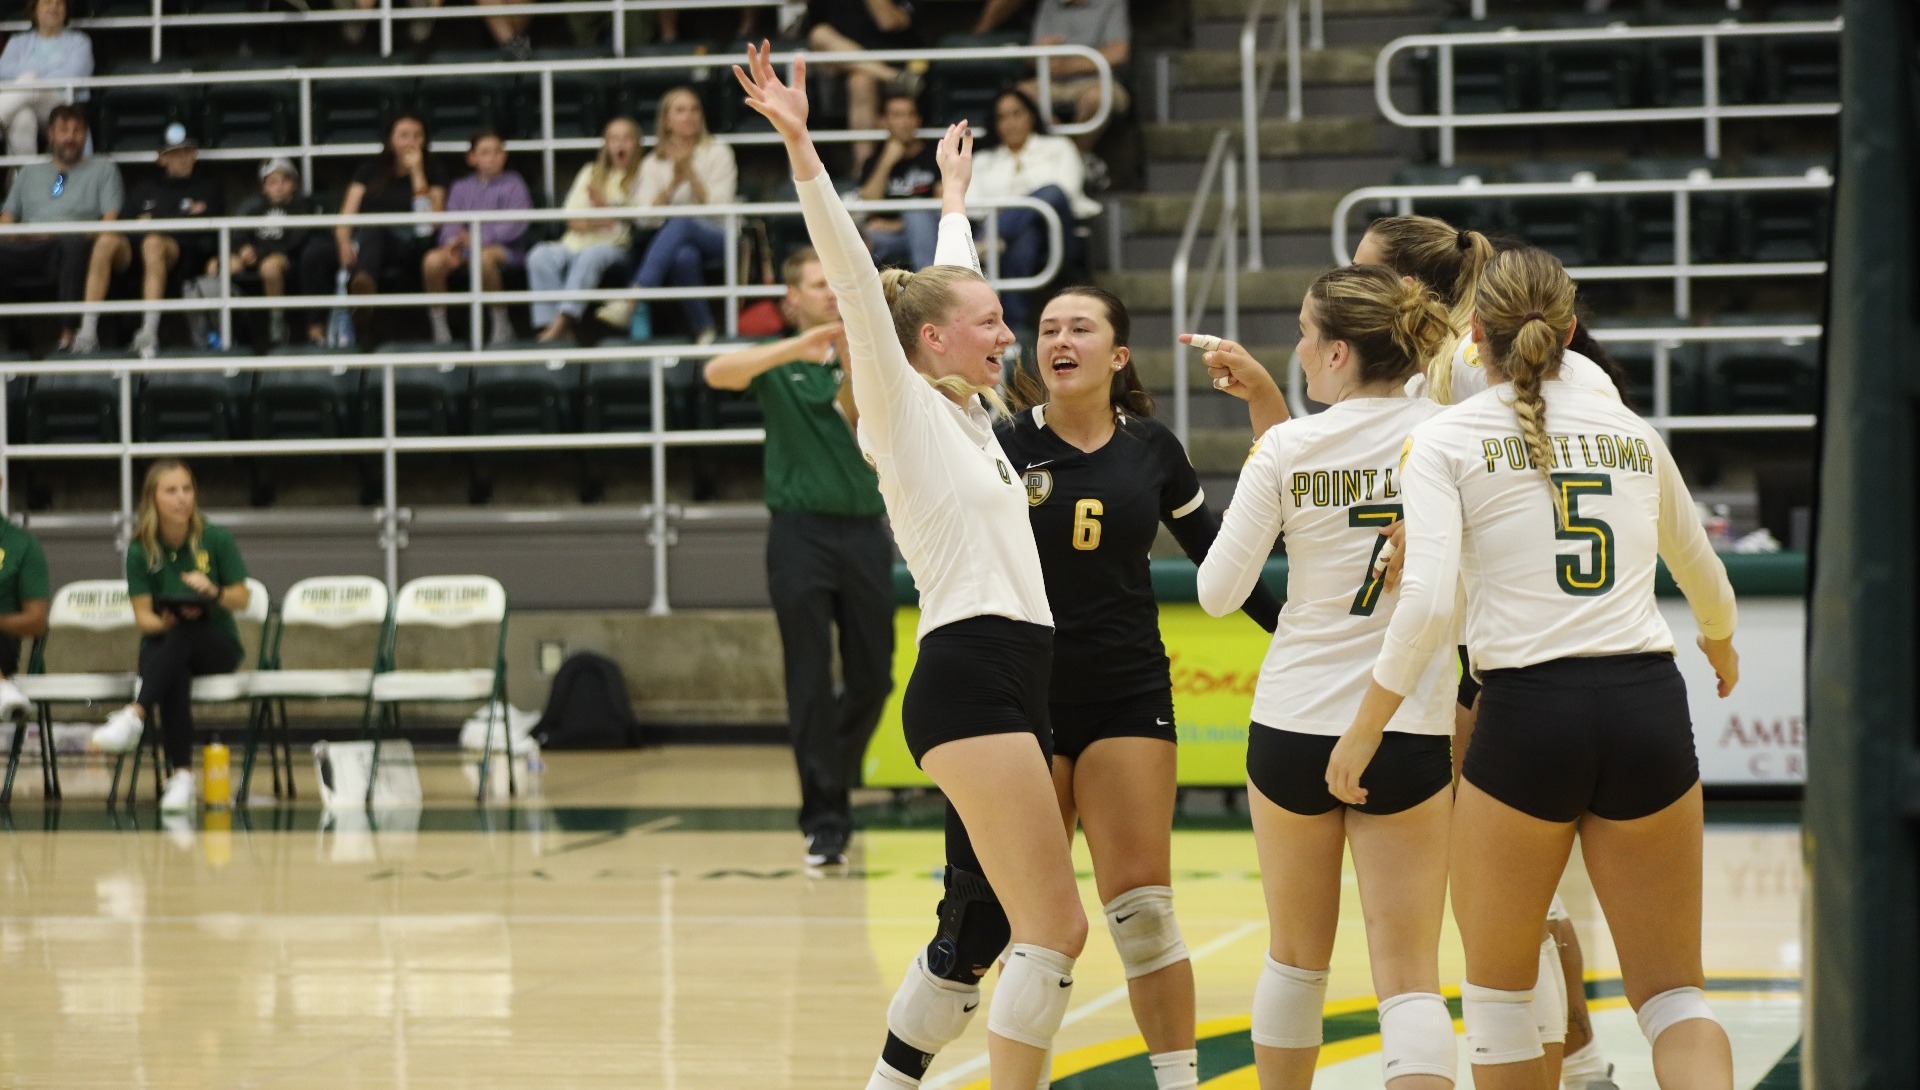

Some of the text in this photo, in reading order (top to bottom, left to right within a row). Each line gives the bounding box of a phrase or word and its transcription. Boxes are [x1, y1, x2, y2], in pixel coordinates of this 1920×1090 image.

[1578, 434, 1653, 475] LOMA
[1290, 468, 1402, 508] POINT L
[1072, 498, 1104, 551] 6
[1550, 472, 1616, 597] 5
[1348, 503, 1405, 617] 7
